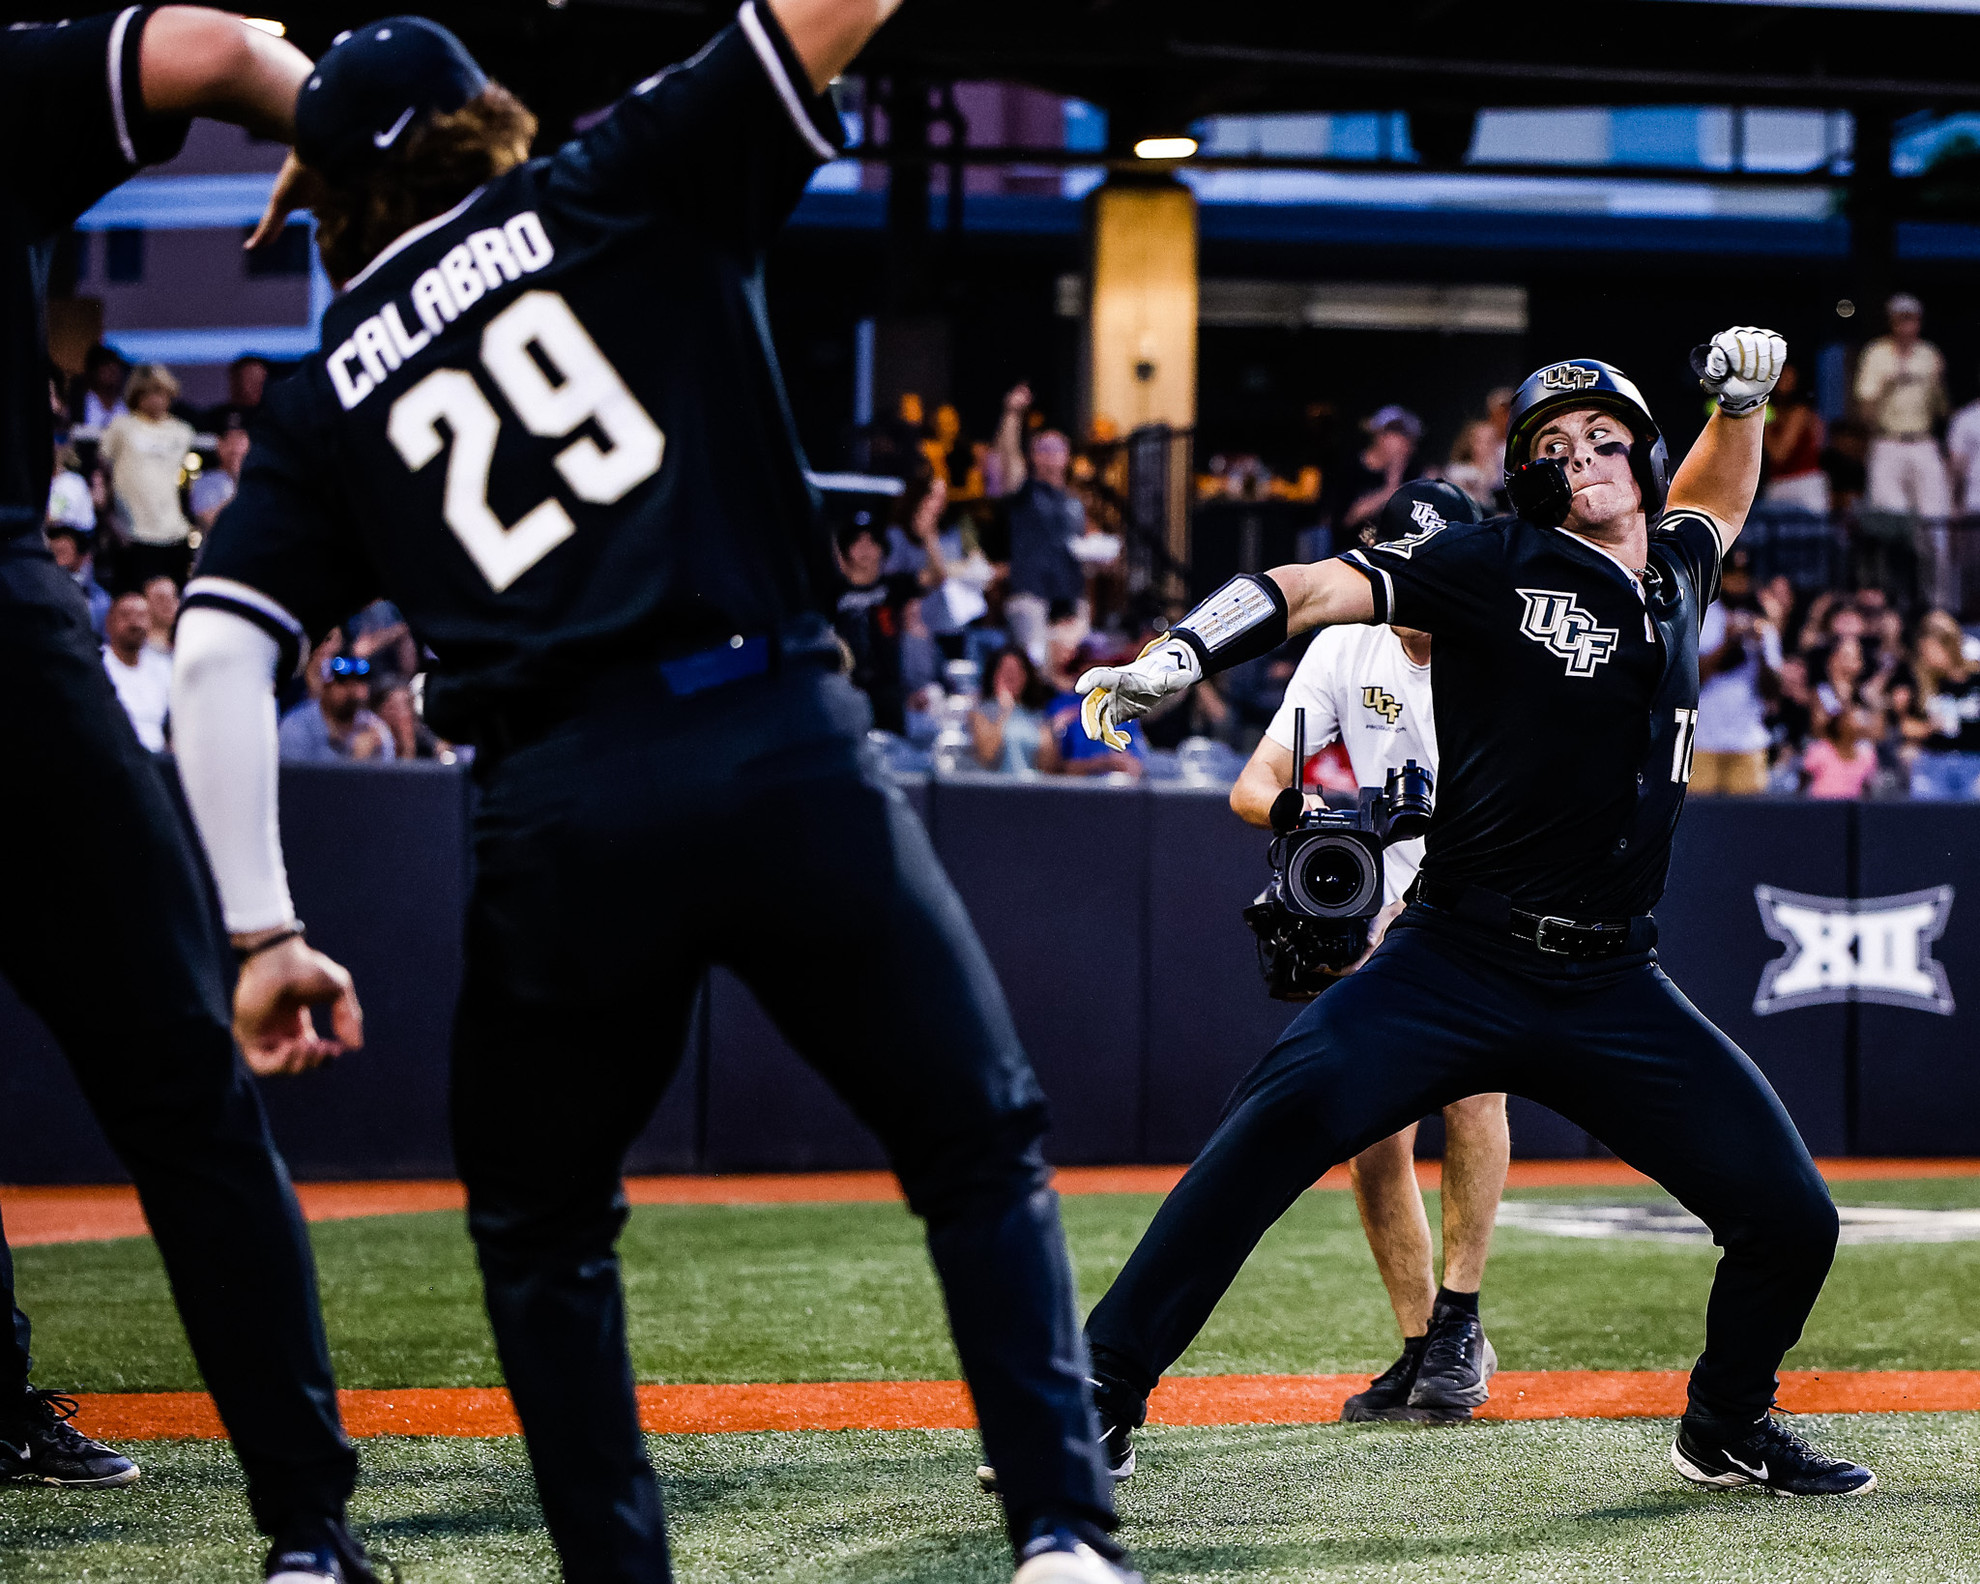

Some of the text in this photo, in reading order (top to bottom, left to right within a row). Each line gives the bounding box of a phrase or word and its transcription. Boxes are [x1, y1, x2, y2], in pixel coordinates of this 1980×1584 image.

[326, 211, 555, 411] CALABRO
[1537, 362, 1600, 391] UCF
[386, 289, 666, 594] 29
[1410, 500, 1447, 534] UCF
[1515, 588, 1619, 678] UCF
[1361, 686, 1403, 725] UCF
